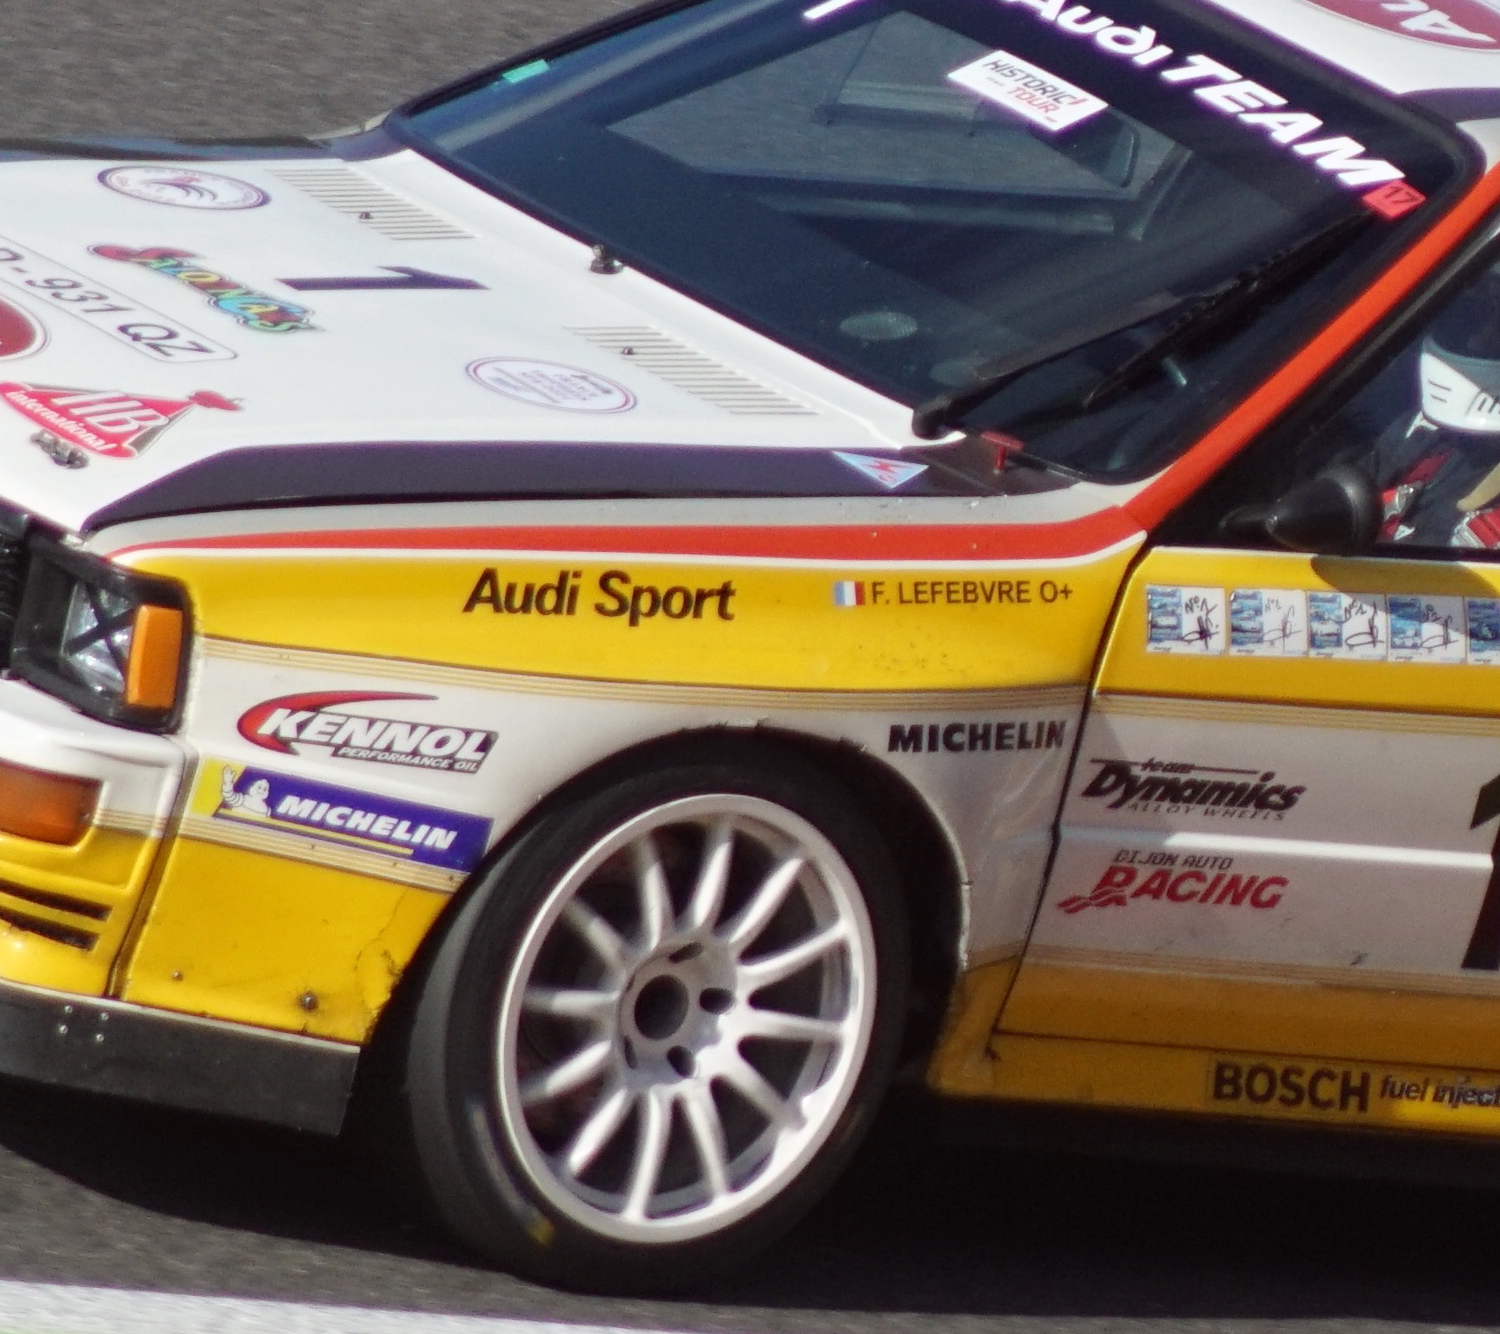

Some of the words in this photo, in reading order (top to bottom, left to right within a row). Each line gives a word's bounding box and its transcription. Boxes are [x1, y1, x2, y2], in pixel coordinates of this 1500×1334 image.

[1007, 87, 1060, 114] TOUR
[1160, 52, 1406, 186] TEAM
[1385, 187, 1418, 204] 17
[275, 266, 492, 292] 1
[117, 322, 215, 358] QZ
[5, 391, 117, 451] international
[462, 567, 583, 616] Audi
[594, 569, 737, 627] Sport
[871, 580, 890, 604] F.
[899, 580, 1032, 604] LEFEBVRE
[1039, 579, 1074, 604] O+
[257, 707, 486, 761] KENNOL
[887, 720, 1067, 753] MICHELIN
[338, 747, 451, 769] PERFORMANCE
[453, 760, 478, 772] OIL
[1082, 763, 1307, 810] Dynamics
[277, 795, 458, 850] MICHELIN
[1127, 802, 1195, 815] ALLOY
[1204, 806, 1286, 821] WHEELS
[1114, 849, 1178, 867] DIJON
[1182, 854, 1234, 870] AUTO
[1058, 864, 1289, 913] RACING
[1212, 1060, 1372, 1113] BOSCH
[1381, 1073, 1431, 1101] fuel
